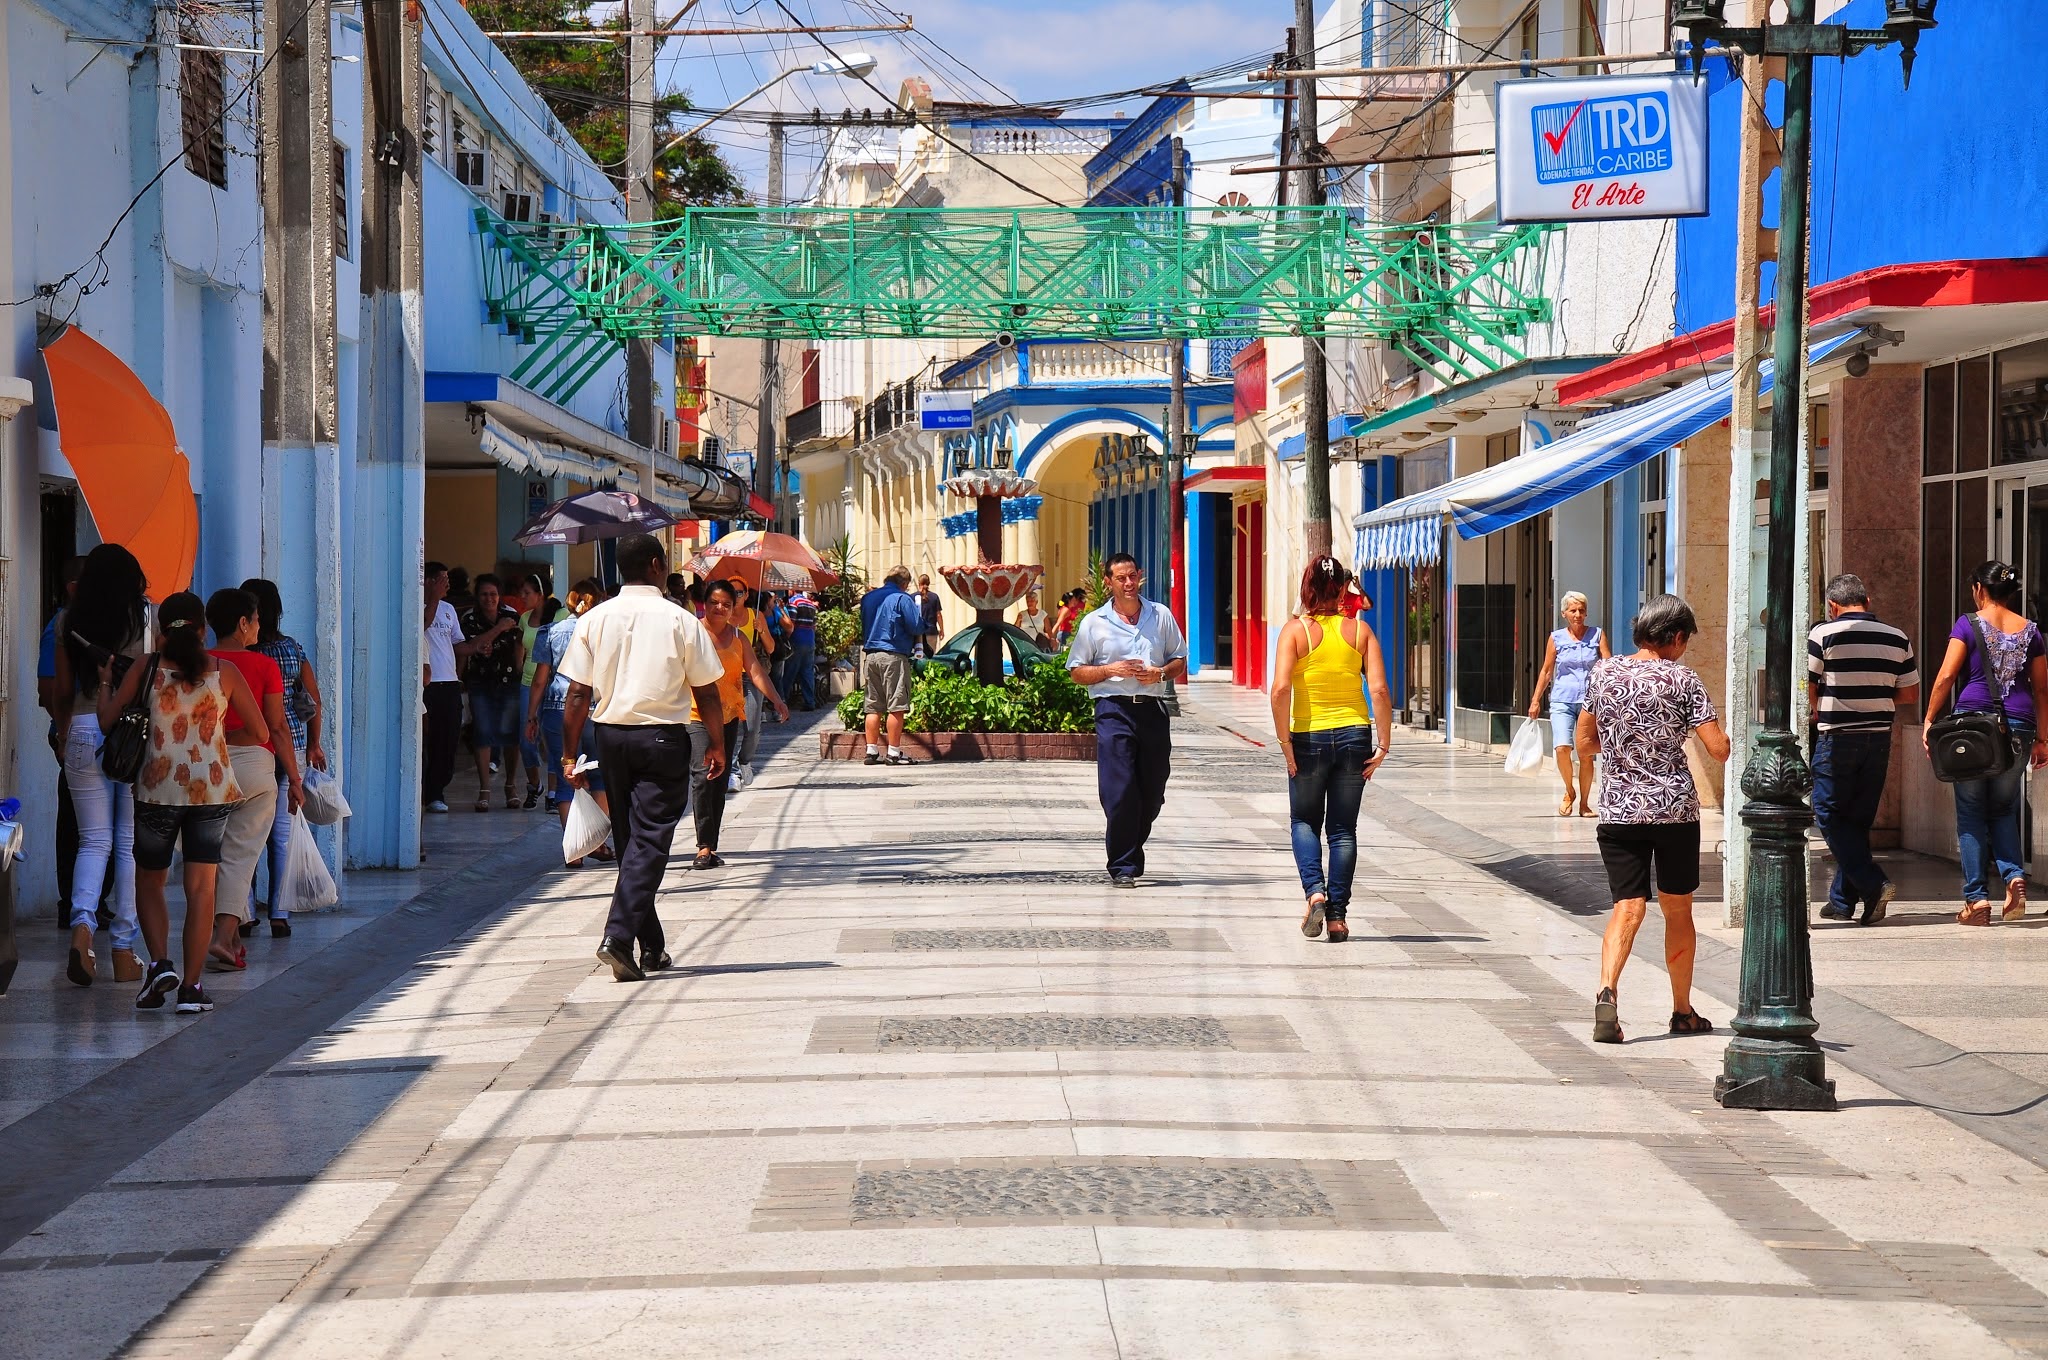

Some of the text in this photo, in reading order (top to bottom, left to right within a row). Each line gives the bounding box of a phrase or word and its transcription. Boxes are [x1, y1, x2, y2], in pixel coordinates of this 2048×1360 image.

[1593, 97, 1667, 149] TRD
[1540, 166, 1594, 180] CADENA DE TIENDAS
[1597, 149, 1667, 173] CARIBE
[1571, 182, 1645, 210] El Arte
